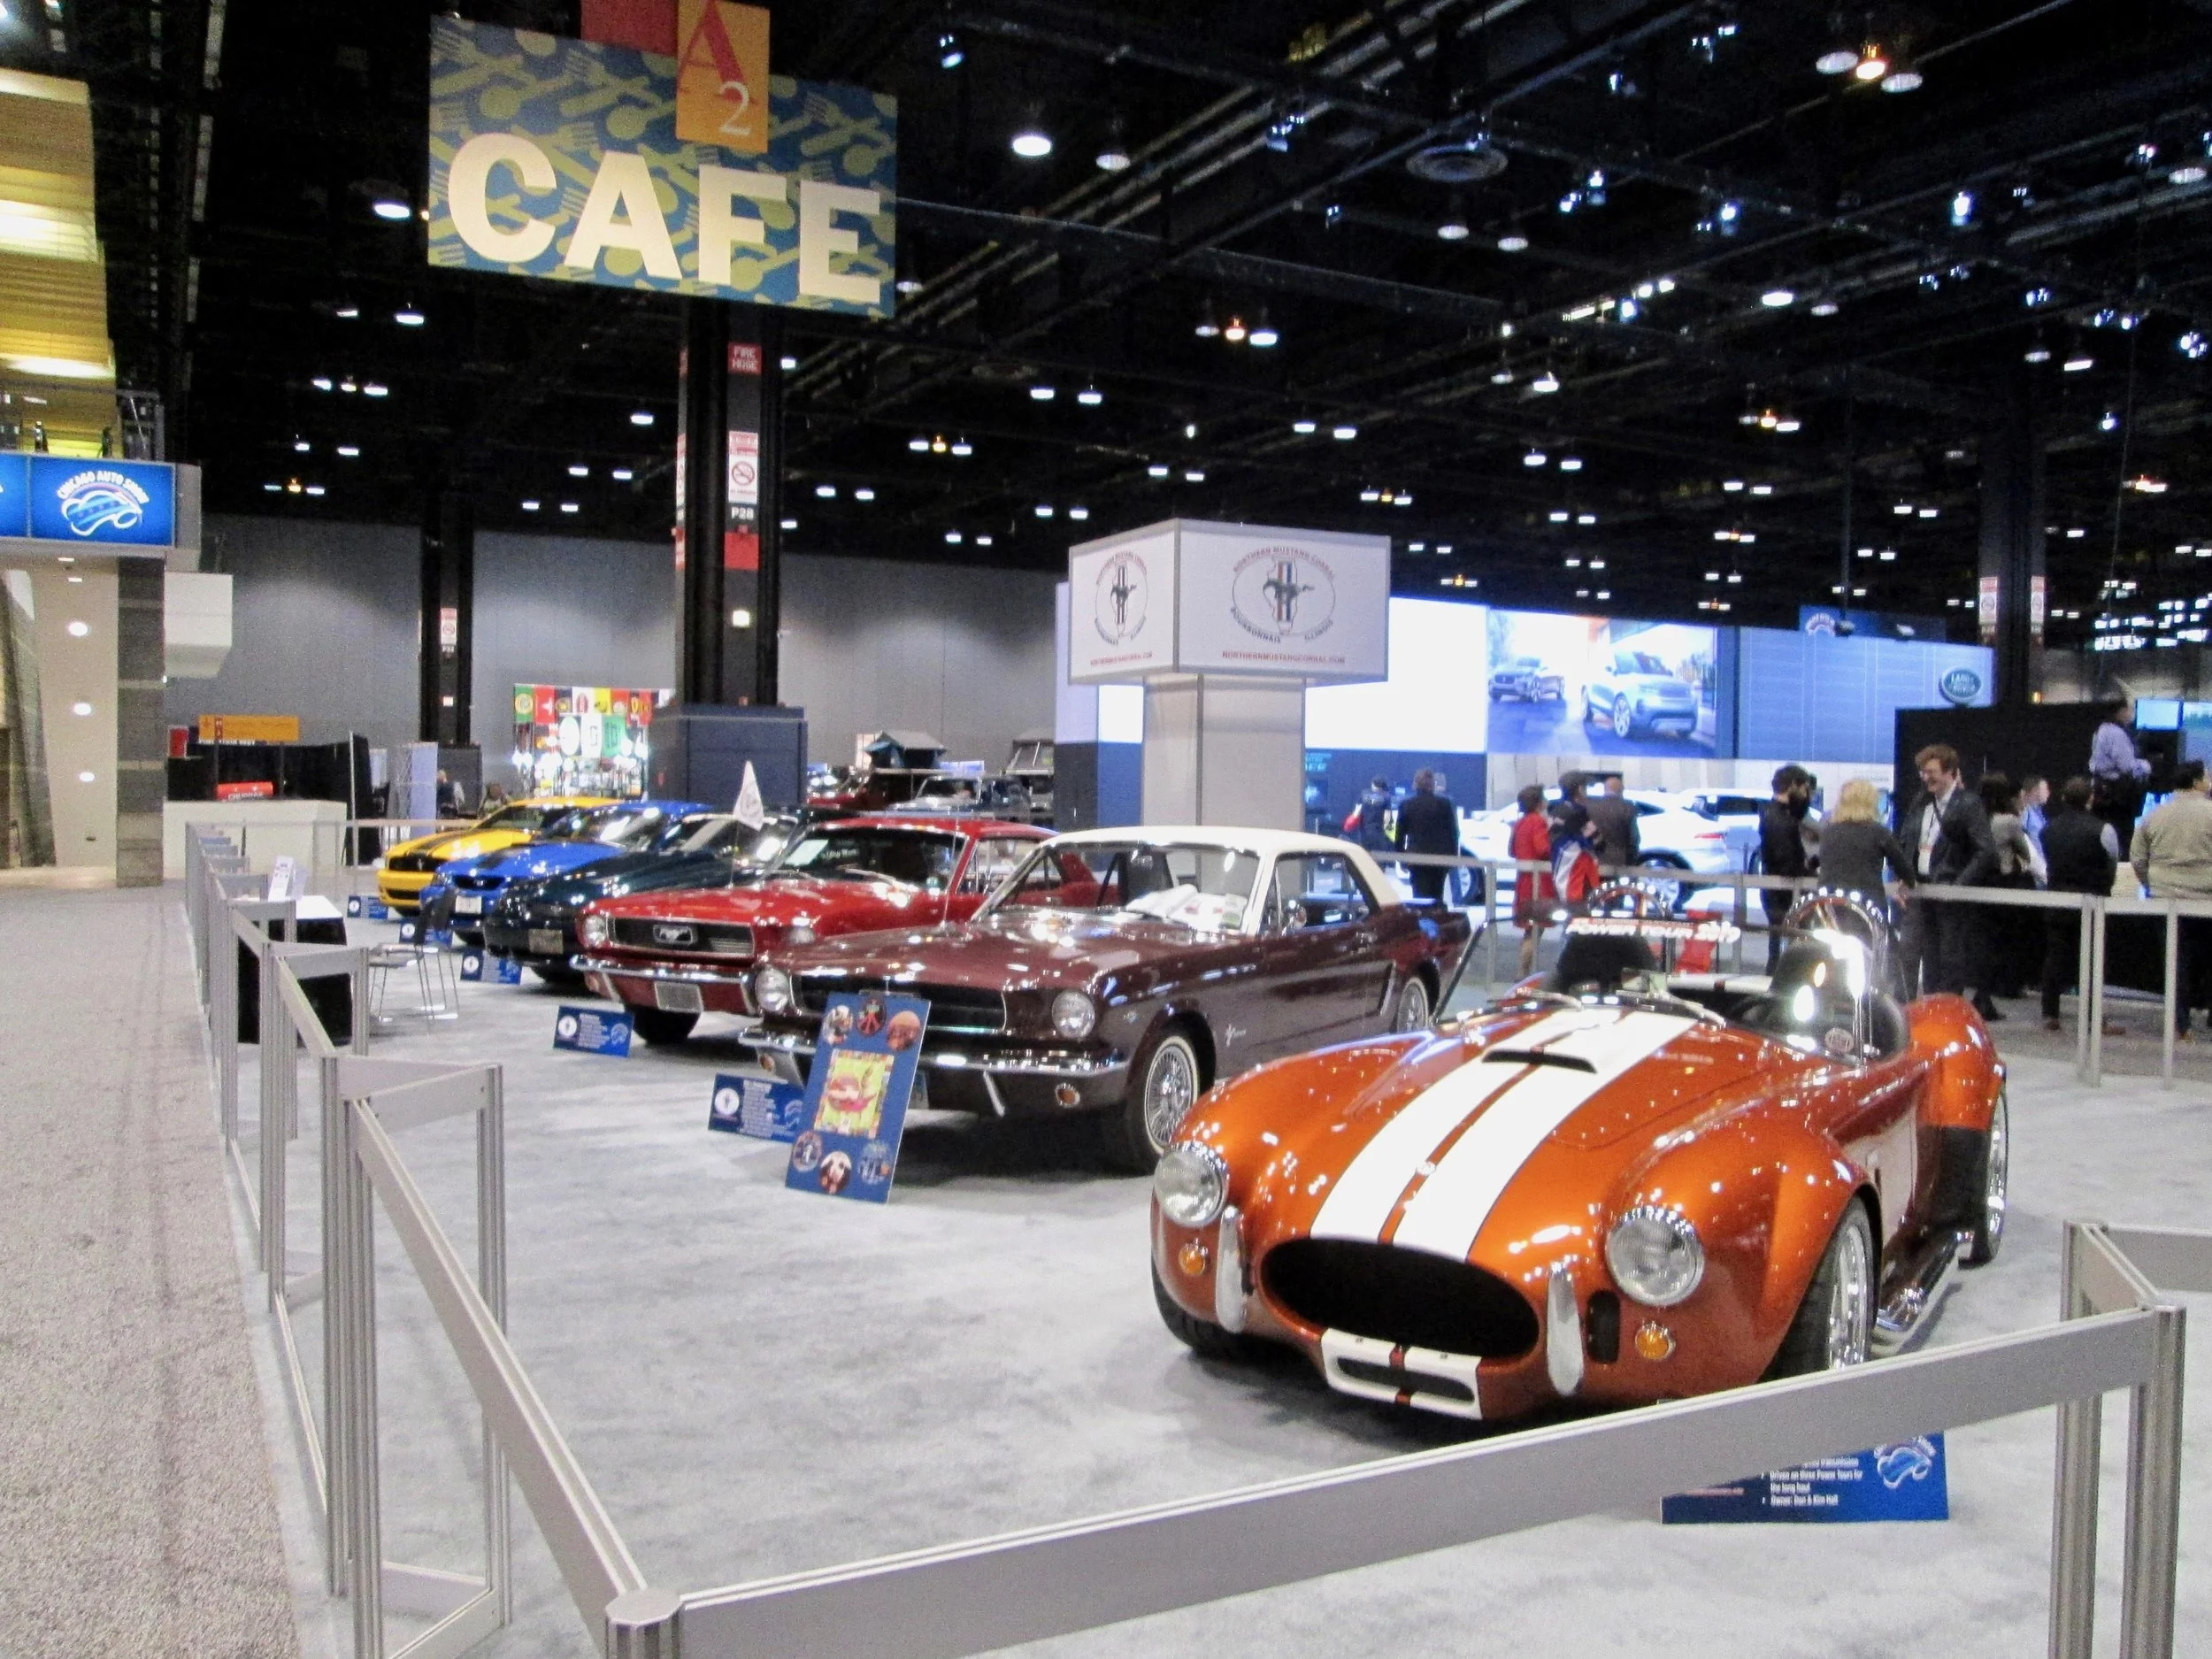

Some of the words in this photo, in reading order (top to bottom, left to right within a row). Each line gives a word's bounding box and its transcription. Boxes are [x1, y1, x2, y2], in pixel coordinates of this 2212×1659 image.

[677, 0, 758, 104] A
[718, 81, 751, 135] 2
[448, 132, 881, 303] CAFE
[734, 345, 757, 359] FIRE
[57, 471, 96, 500] CHICAGO
[96, 470, 125, 486] AUTO
[123, 478, 150, 503] SHOW
[1233, 547, 1271, 572] NORTHERN
[1272, 546, 1310, 558] MUSTANG
[1565, 923, 1637, 935] POWER
[1640, 925, 1694, 940] TOUR
[1770, 1482, 1781, 1493] the
[1782, 1482, 1795, 1494] long
[1816, 1470, 1836, 1480] Power
